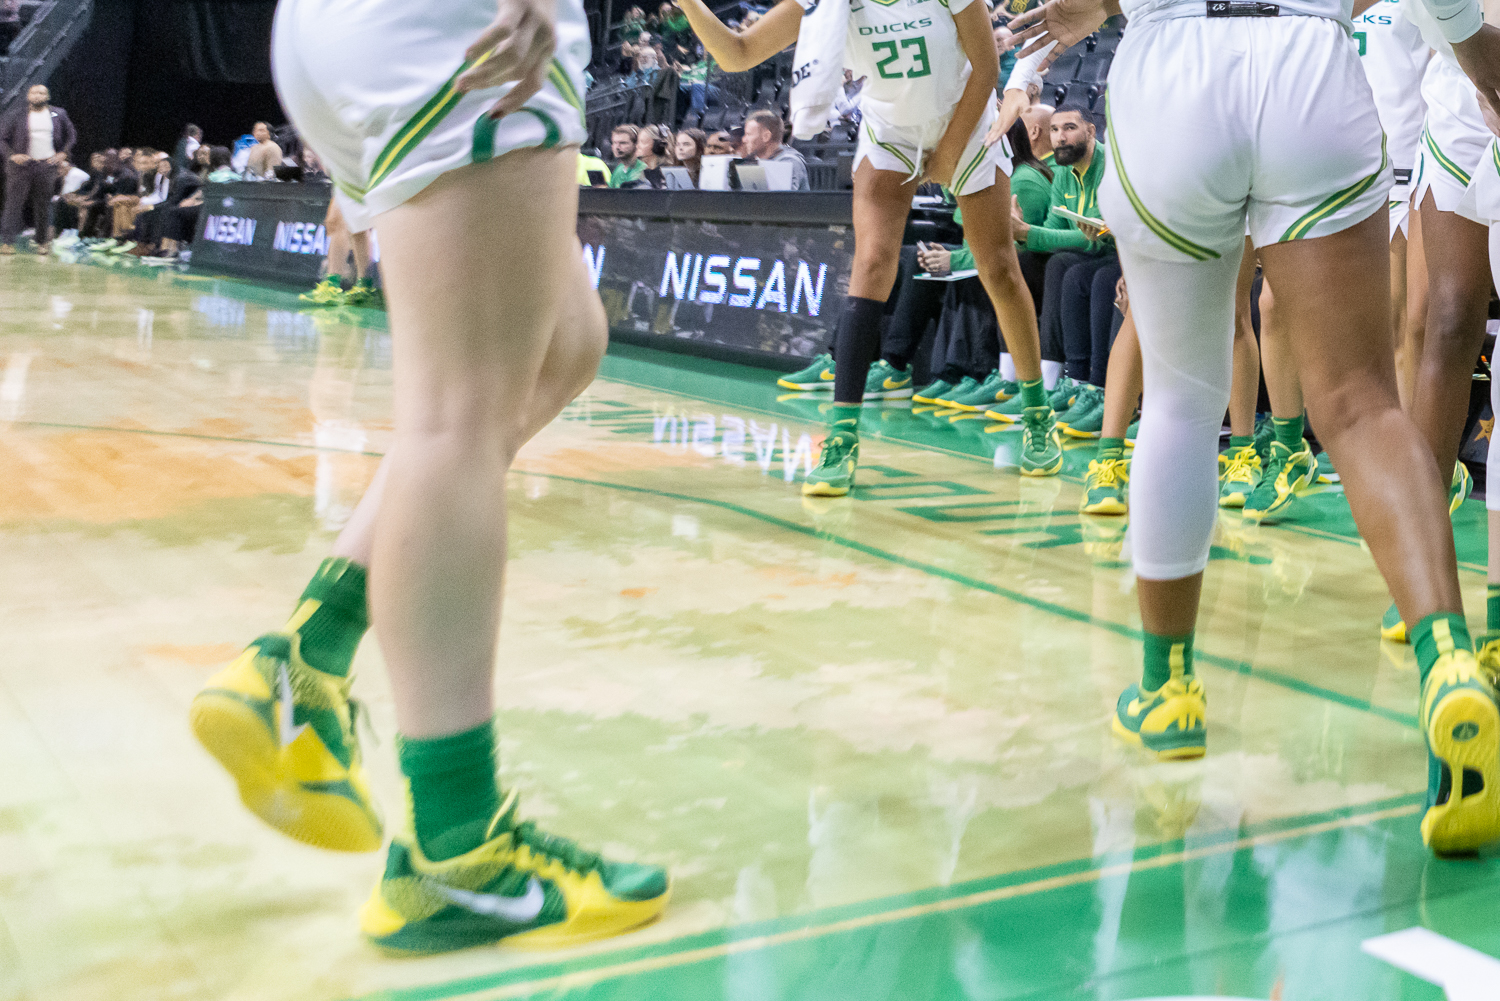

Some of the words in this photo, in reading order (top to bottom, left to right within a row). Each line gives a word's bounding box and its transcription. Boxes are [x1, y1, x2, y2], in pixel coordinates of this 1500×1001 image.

[858, 17, 933, 36] DUCKS
[872, 36, 932, 79] 23
[204, 214, 257, 245] NISSAN
[659, 250, 828, 317] NISSAN
